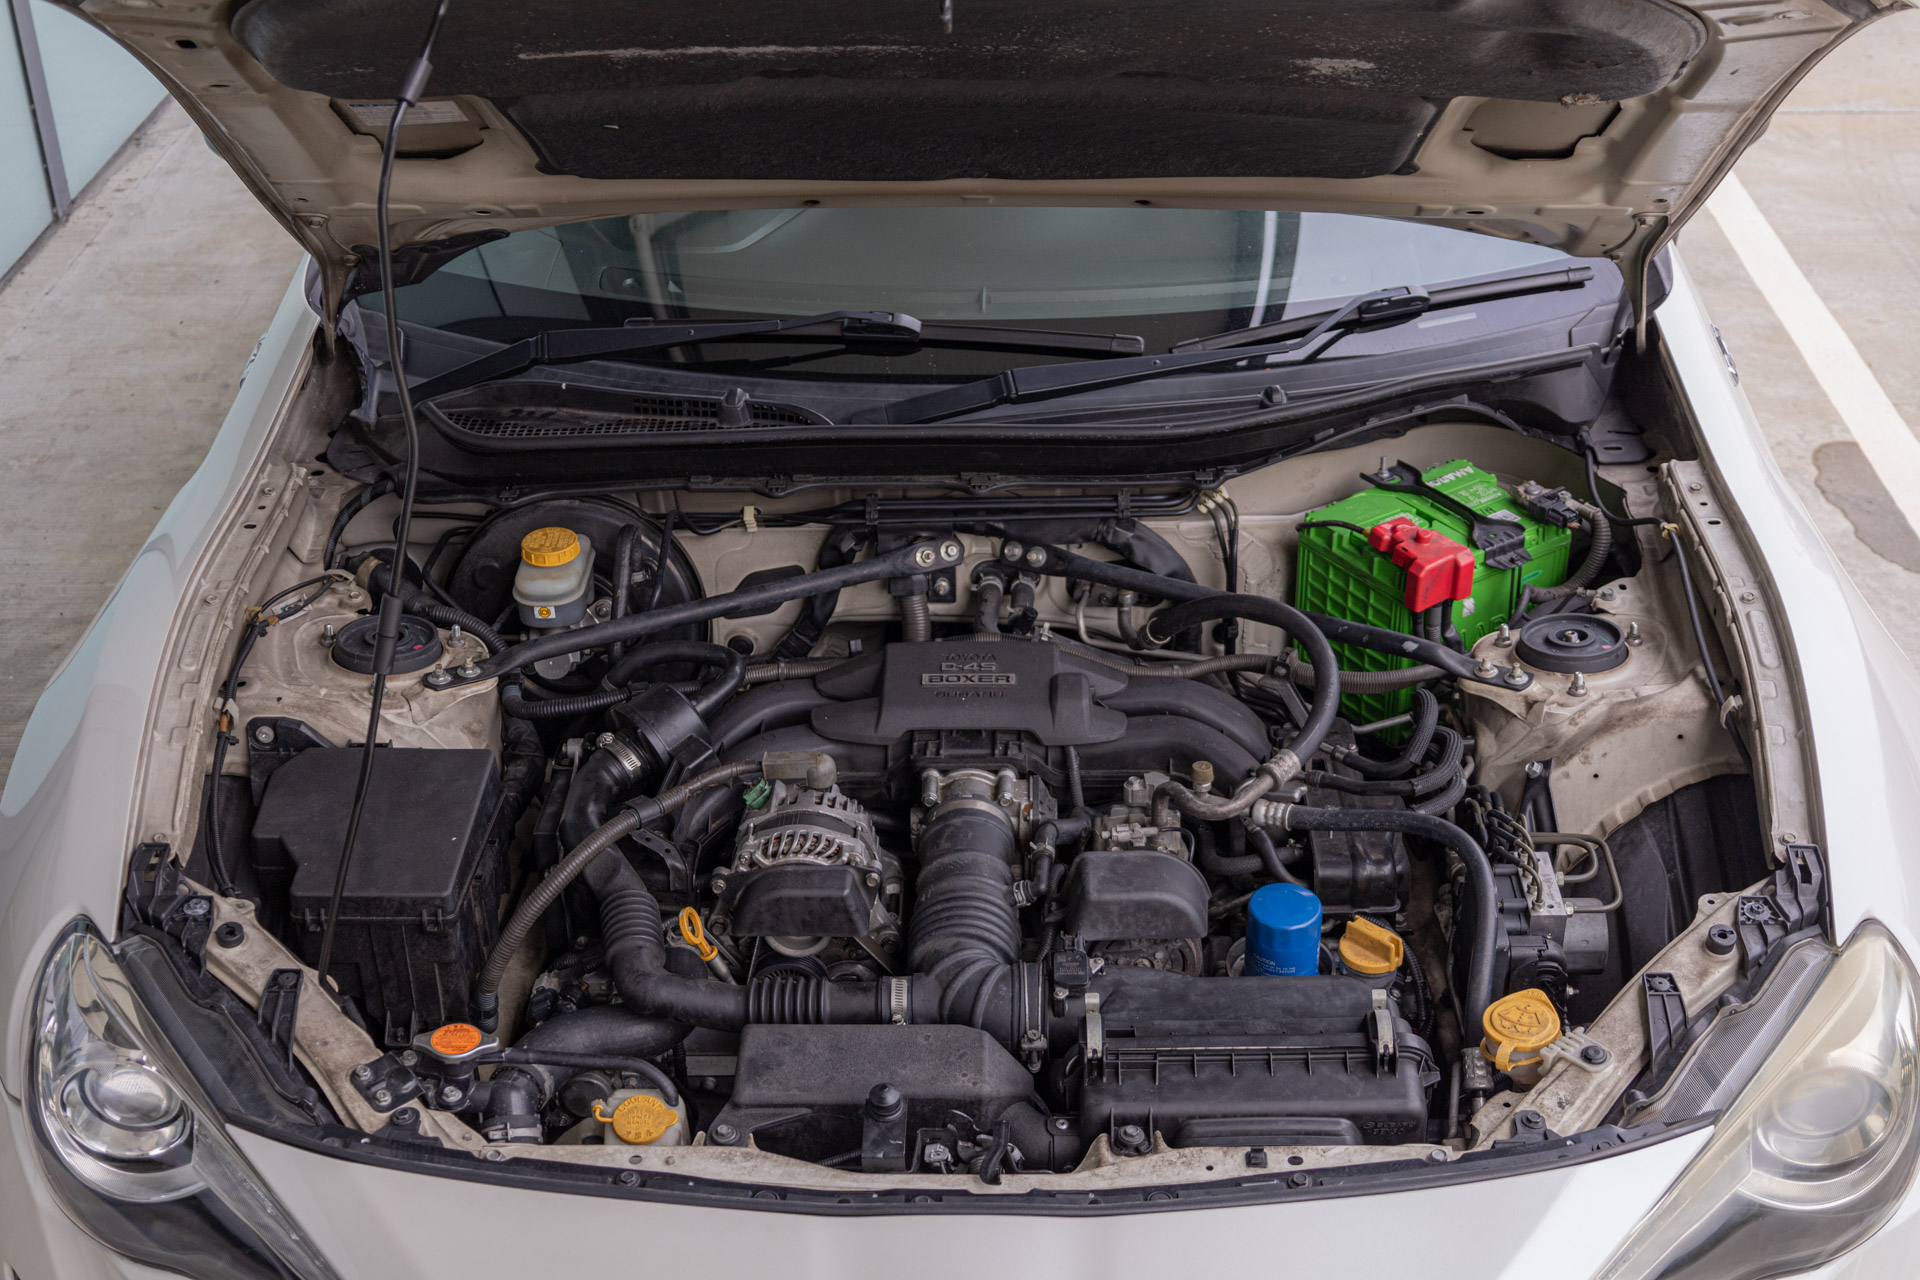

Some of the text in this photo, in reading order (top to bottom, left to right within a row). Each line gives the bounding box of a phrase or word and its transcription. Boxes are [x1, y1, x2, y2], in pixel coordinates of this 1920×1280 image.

[941, 662, 996, 671] D-4S
[927, 674, 1010, 683] BOXER
[934, 690, 1004, 698] SUBARU
[618, 1095, 663, 1112] COOLANT
